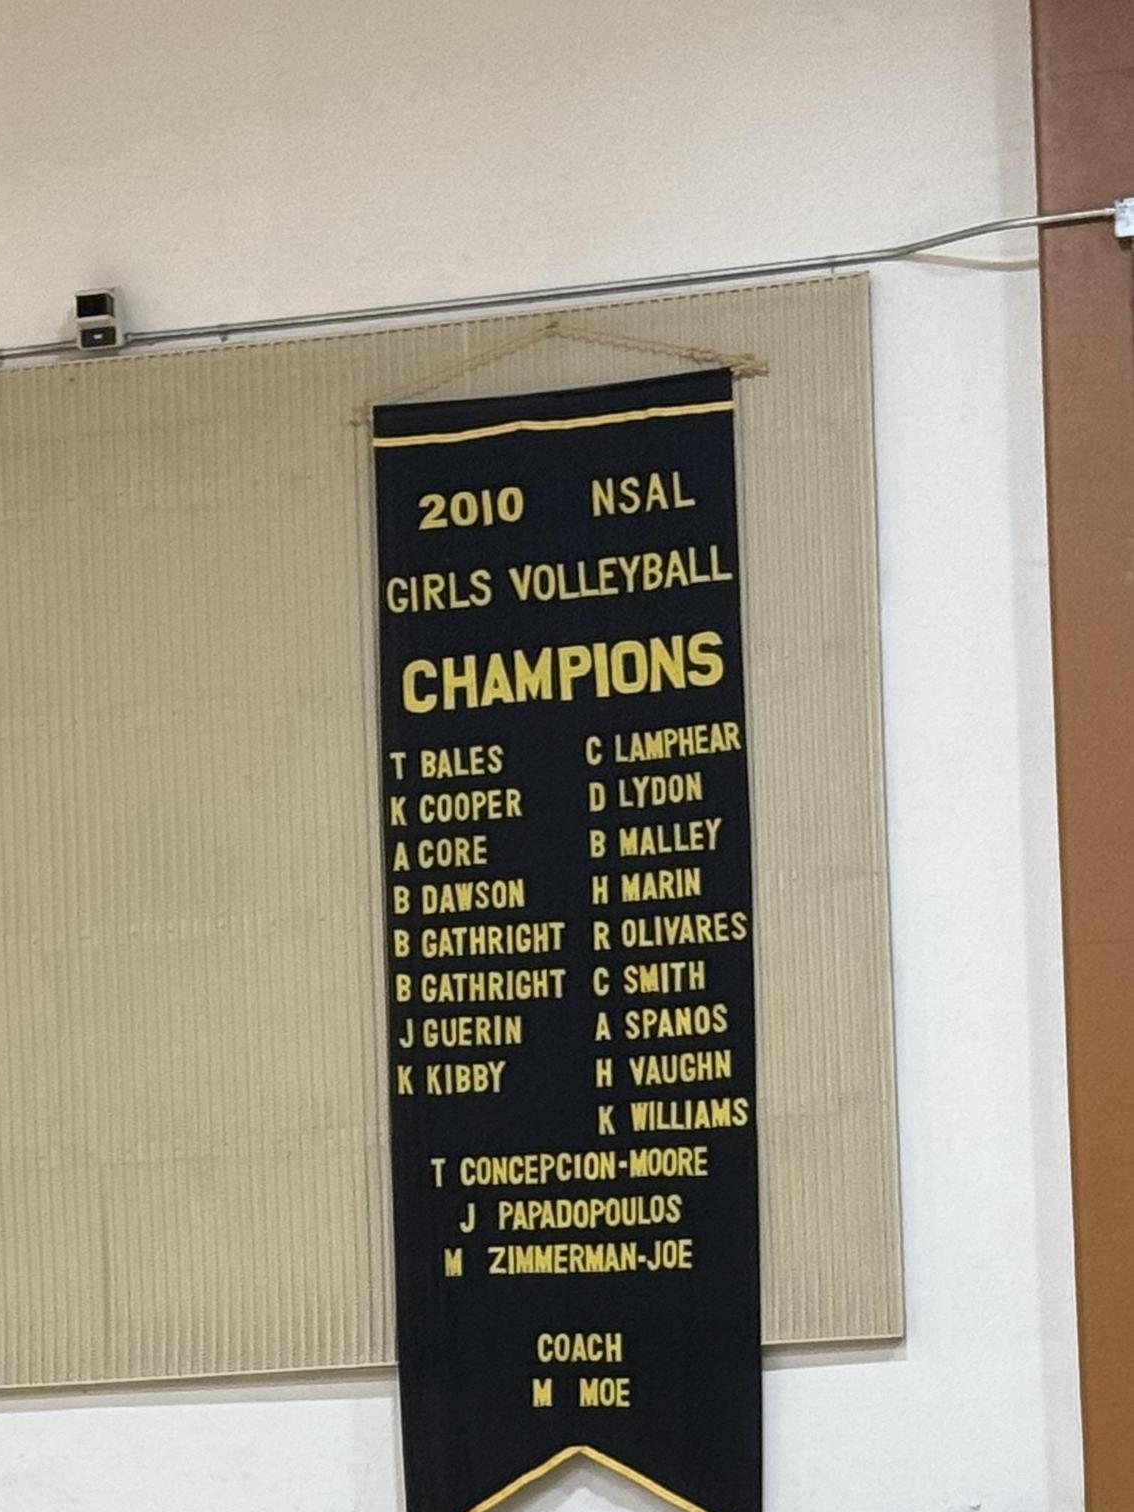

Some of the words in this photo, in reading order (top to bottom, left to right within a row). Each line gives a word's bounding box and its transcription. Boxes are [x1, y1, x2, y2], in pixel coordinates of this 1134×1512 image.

[419, 487, 523, 529] 2010
[593, 472, 695, 516] NSAL
[387, 570, 491, 613] GIRLS
[509, 545, 732, 600] VOLLEYBALL
[403, 631, 723, 713] CHAMPIONS
[586, 736, 602, 765] C
[615, 722, 741, 762] LAMPHEAR
[390, 752, 406, 780] T
[421, 745, 503, 779] BALES
[391, 797, 407, 825] K
[420, 789, 522, 823] COOPER
[589, 782, 605, 812] D
[619, 772, 702, 808] LYDON
[393, 842, 410, 871] A
[418, 836, 487, 869] CORE
[590, 830, 606, 857] B
[619, 818, 721, 856] MALLEY
[394, 886, 410, 914] B
[422, 879, 524, 914] DAWSON
[592, 876, 608, 904] H
[622, 868, 701, 902] MARIN
[394, 929, 410, 957] B
[422, 922, 565, 958] GATHRIGHT
[594, 921, 611, 950] R
[622, 912, 747, 947] OLIVARES
[396, 974, 411, 1002] B
[422, 969, 566, 1002] GATHRIGHT
[593, 967, 609, 996] C
[624, 961, 705, 994] SMITH
[399, 1019, 413, 1048] J
[423, 1015, 521, 1047] GUERIN
[595, 1012, 611, 1041] A
[625, 1004, 727, 1039] SPANOS
[398, 1065, 413, 1094] K
[427, 1061, 506, 1095] KIBBY
[596, 1058, 612, 1087] H
[629, 1050, 731, 1085] VAUGHN
[599, 1106, 615, 1135] K
[631, 1098, 749, 1131] WILLIAMS
[431, 1158, 445, 1187] T
[460, 1146, 708, 1186] CONCEPCION-MOORE
[460, 1203, 475, 1233] J
[499, 1194, 682, 1230] PAPADOPOULOS
[445, 1248, 462, 1276] M
[488, 1239, 692, 1274] ZIMMERMAN-JOE
[538, 1333, 622, 1362] COACH
[533, 1378, 552, 1407] M
[580, 1378, 630, 1407] MOE
